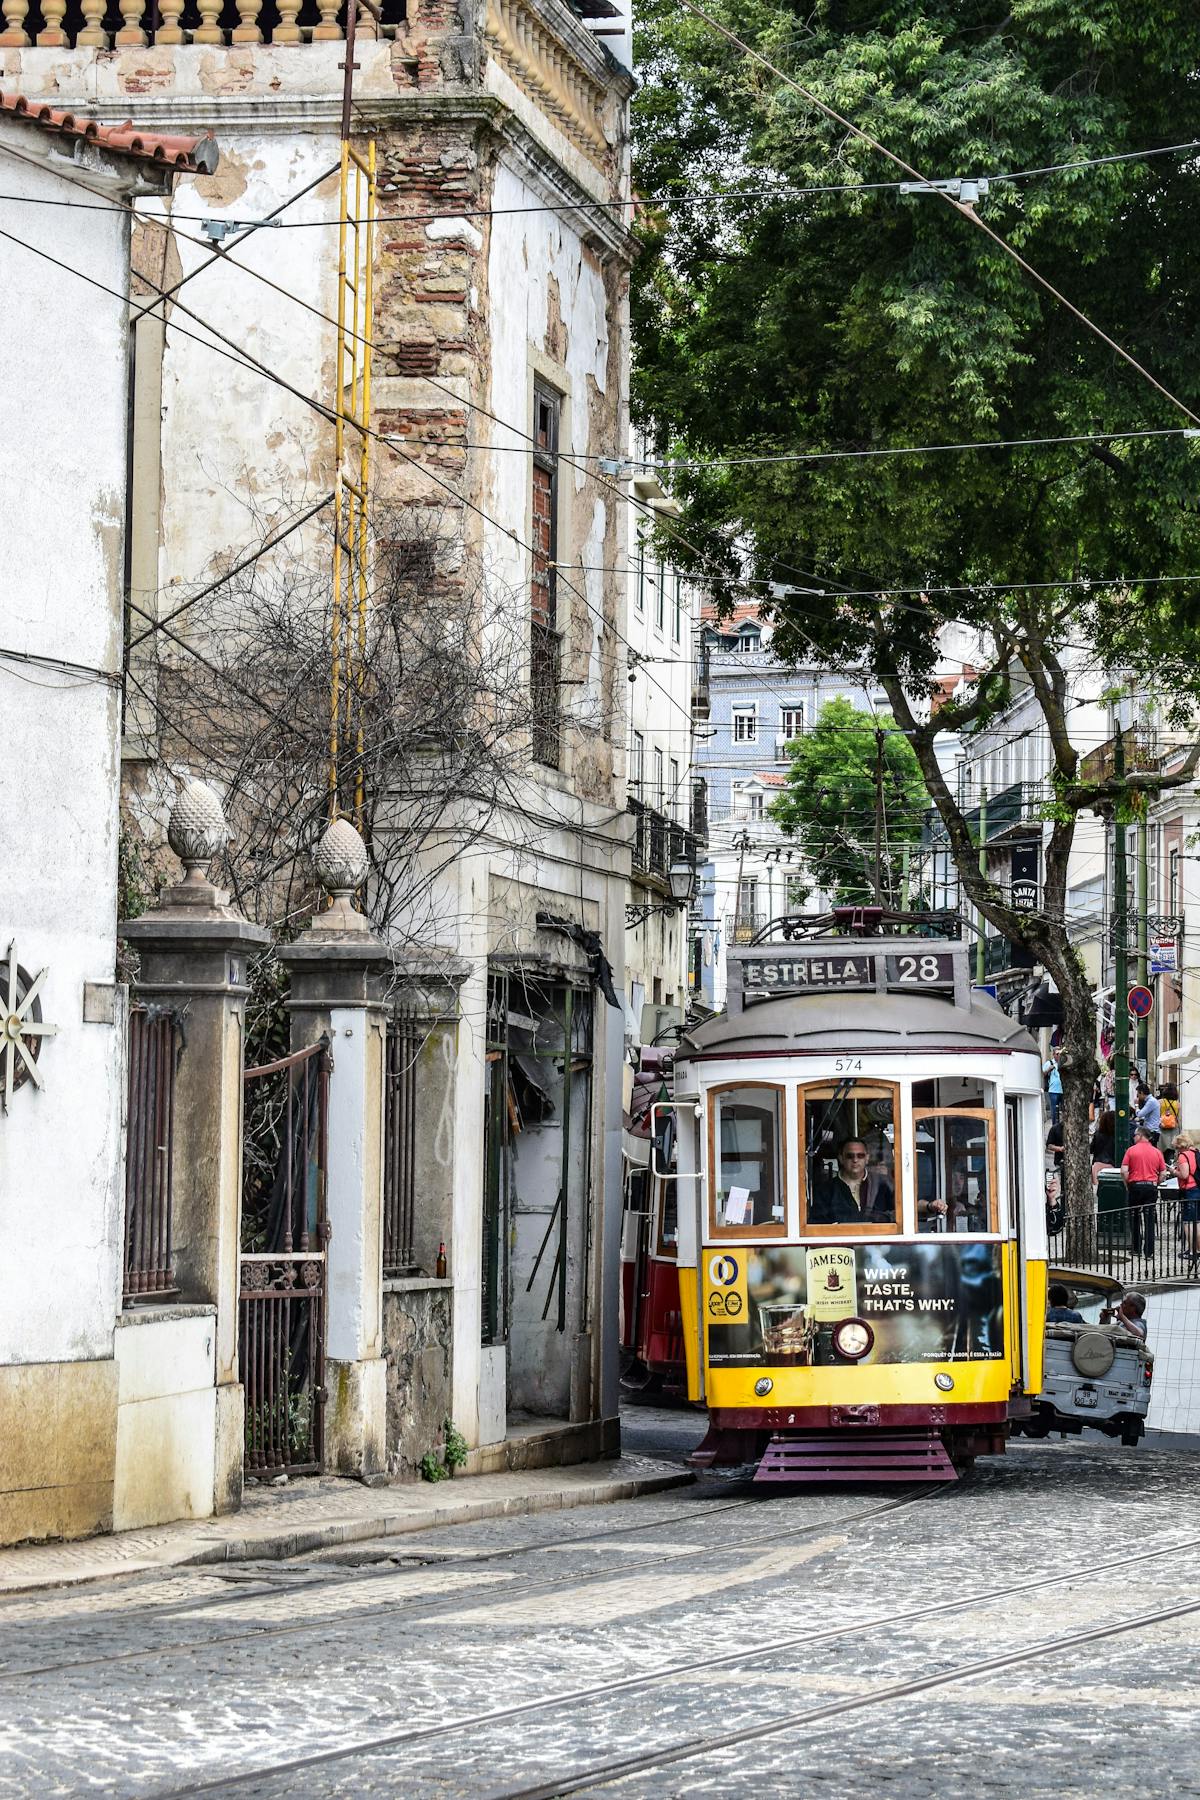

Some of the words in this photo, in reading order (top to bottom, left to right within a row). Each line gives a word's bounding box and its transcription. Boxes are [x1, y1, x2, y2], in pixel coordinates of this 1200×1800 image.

[1013, 887, 1035, 898] SANTA
[747, 960, 859, 983] ESTRELA
[899, 955, 940, 982] 28
[835, 1058, 862, 1071] 574
[810, 1254, 854, 1269] JAMESON
[864, 1268, 907, 1280] WHY?
[864, 1284, 914, 1297] TASTE,
[864, 1299, 915, 1311] THAT'S
